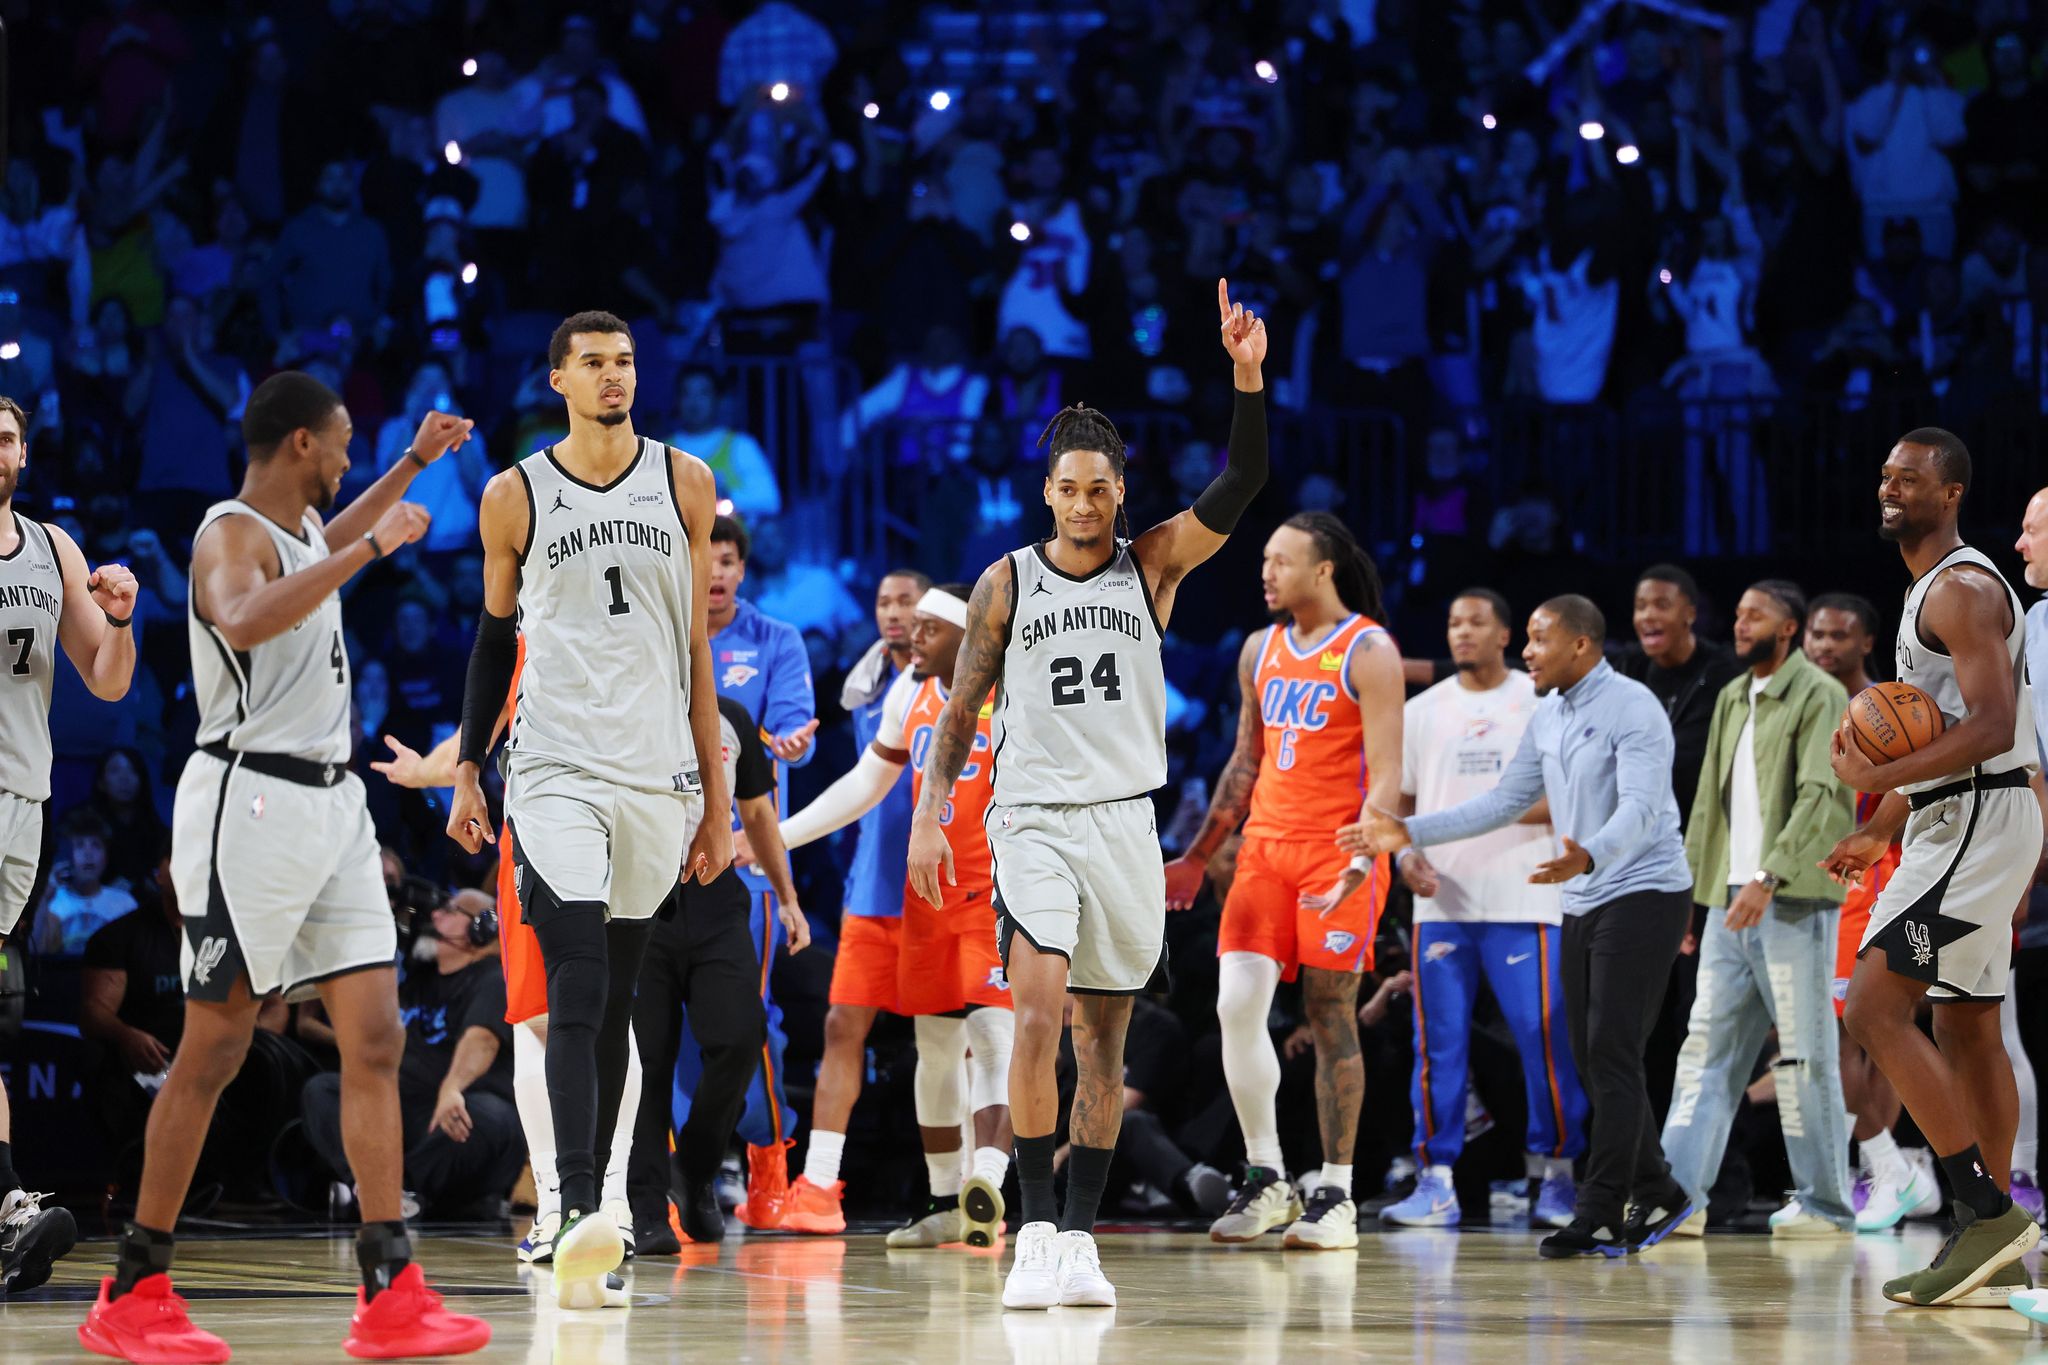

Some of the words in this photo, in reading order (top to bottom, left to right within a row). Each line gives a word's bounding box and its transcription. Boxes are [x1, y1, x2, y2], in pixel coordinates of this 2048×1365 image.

[633, 495, 659, 503] LEDGER
[547, 527, 584, 570] SAN
[588, 519, 672, 558] ANTONIO
[603, 565, 631, 616] 1
[1103, 580, 1129, 588] LEDGER
[7, 627, 35, 676] 7
[1021, 611, 1057, 652] SAN
[1062, 605, 1142, 642] ANTONIO
[330, 629, 345, 685] 4
[1049, 652, 1122, 707] 24
[1262, 676, 1337, 731] OKC
[911, 723, 990, 781] OC
[1277, 729, 1298, 771] 6
